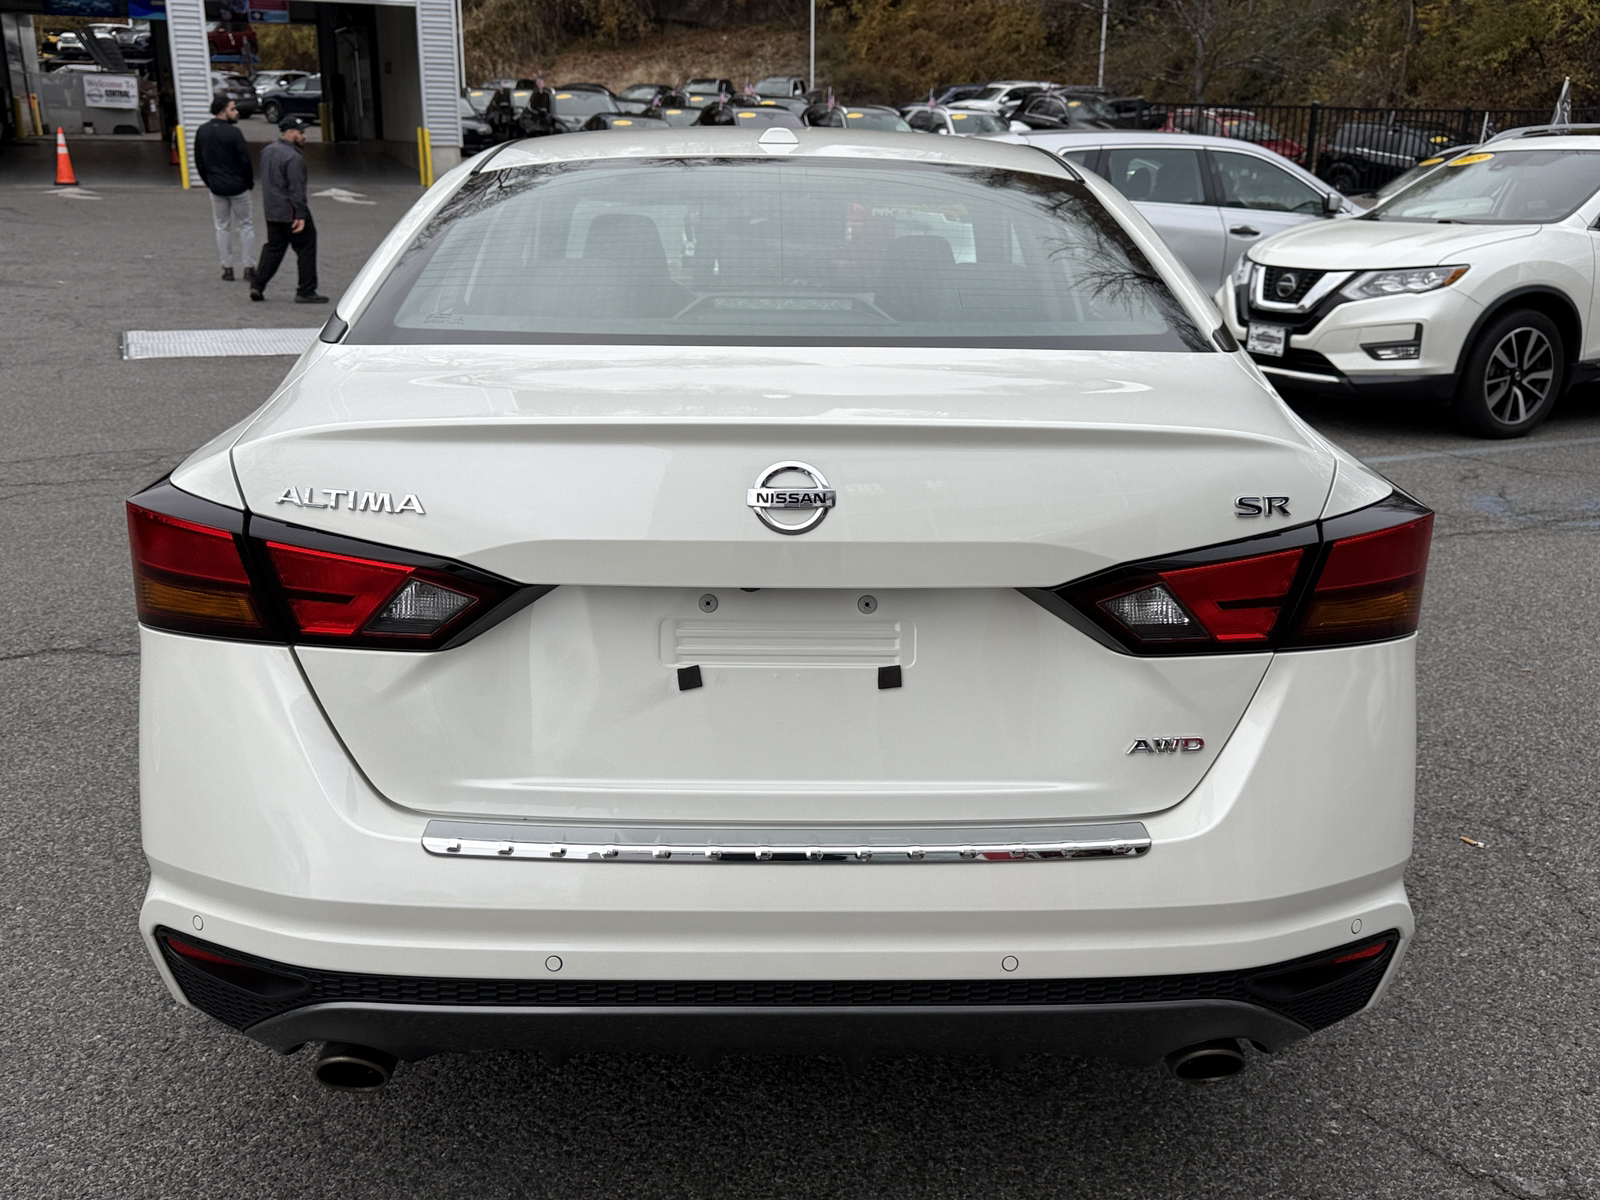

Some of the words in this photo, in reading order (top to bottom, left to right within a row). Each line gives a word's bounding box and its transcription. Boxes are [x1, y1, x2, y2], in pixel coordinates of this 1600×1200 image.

[275, 485, 427, 515] ALTIMA
[756, 492, 827, 504] NISSAN
[1234, 495, 1292, 518] SR
[1126, 736, 1204, 755] AWD
